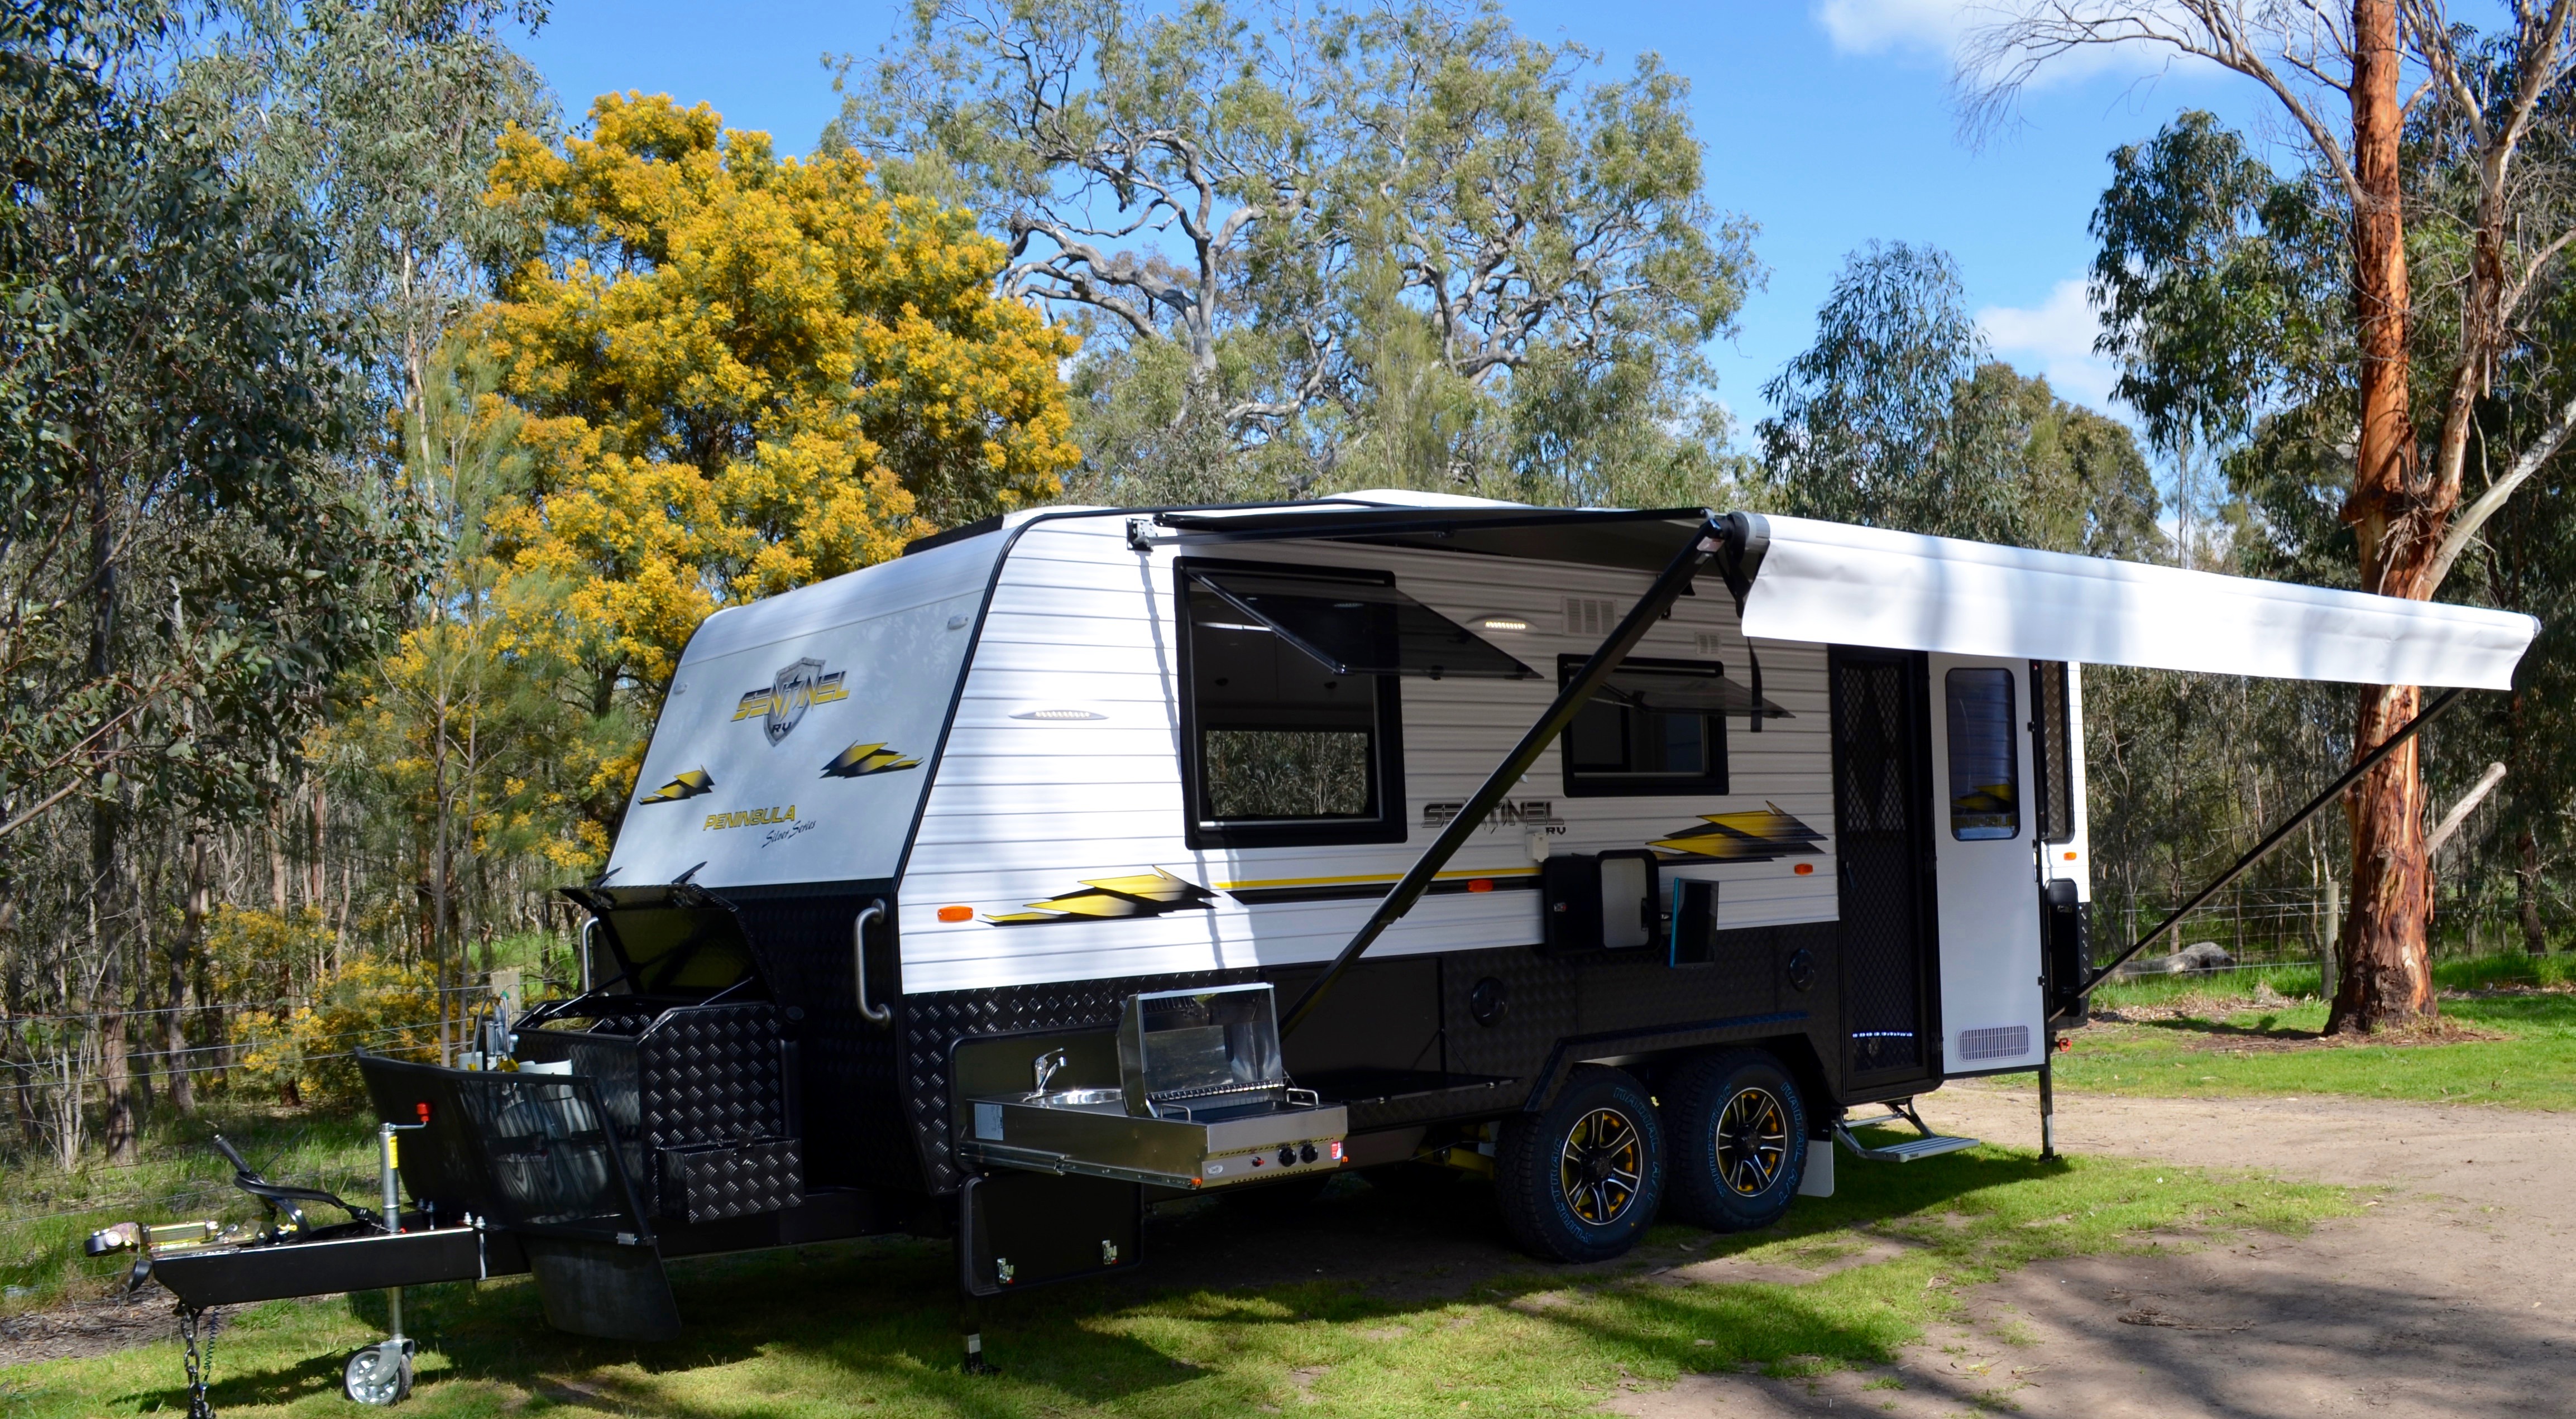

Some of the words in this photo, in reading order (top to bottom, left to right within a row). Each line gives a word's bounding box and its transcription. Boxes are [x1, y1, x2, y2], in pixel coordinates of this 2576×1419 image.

[730, 670, 850, 722] SENTINEL
[771, 721, 792, 734] RV
[703, 805, 796, 831] PENINSULA
[788, 820, 816, 839] Series
[1421, 797, 1565, 834] SETINEL
[1545, 826, 1567, 836] RV
[1613, 1087, 1660, 1153] RADIAL
[1780, 1081, 1805, 1162] RADIAL
